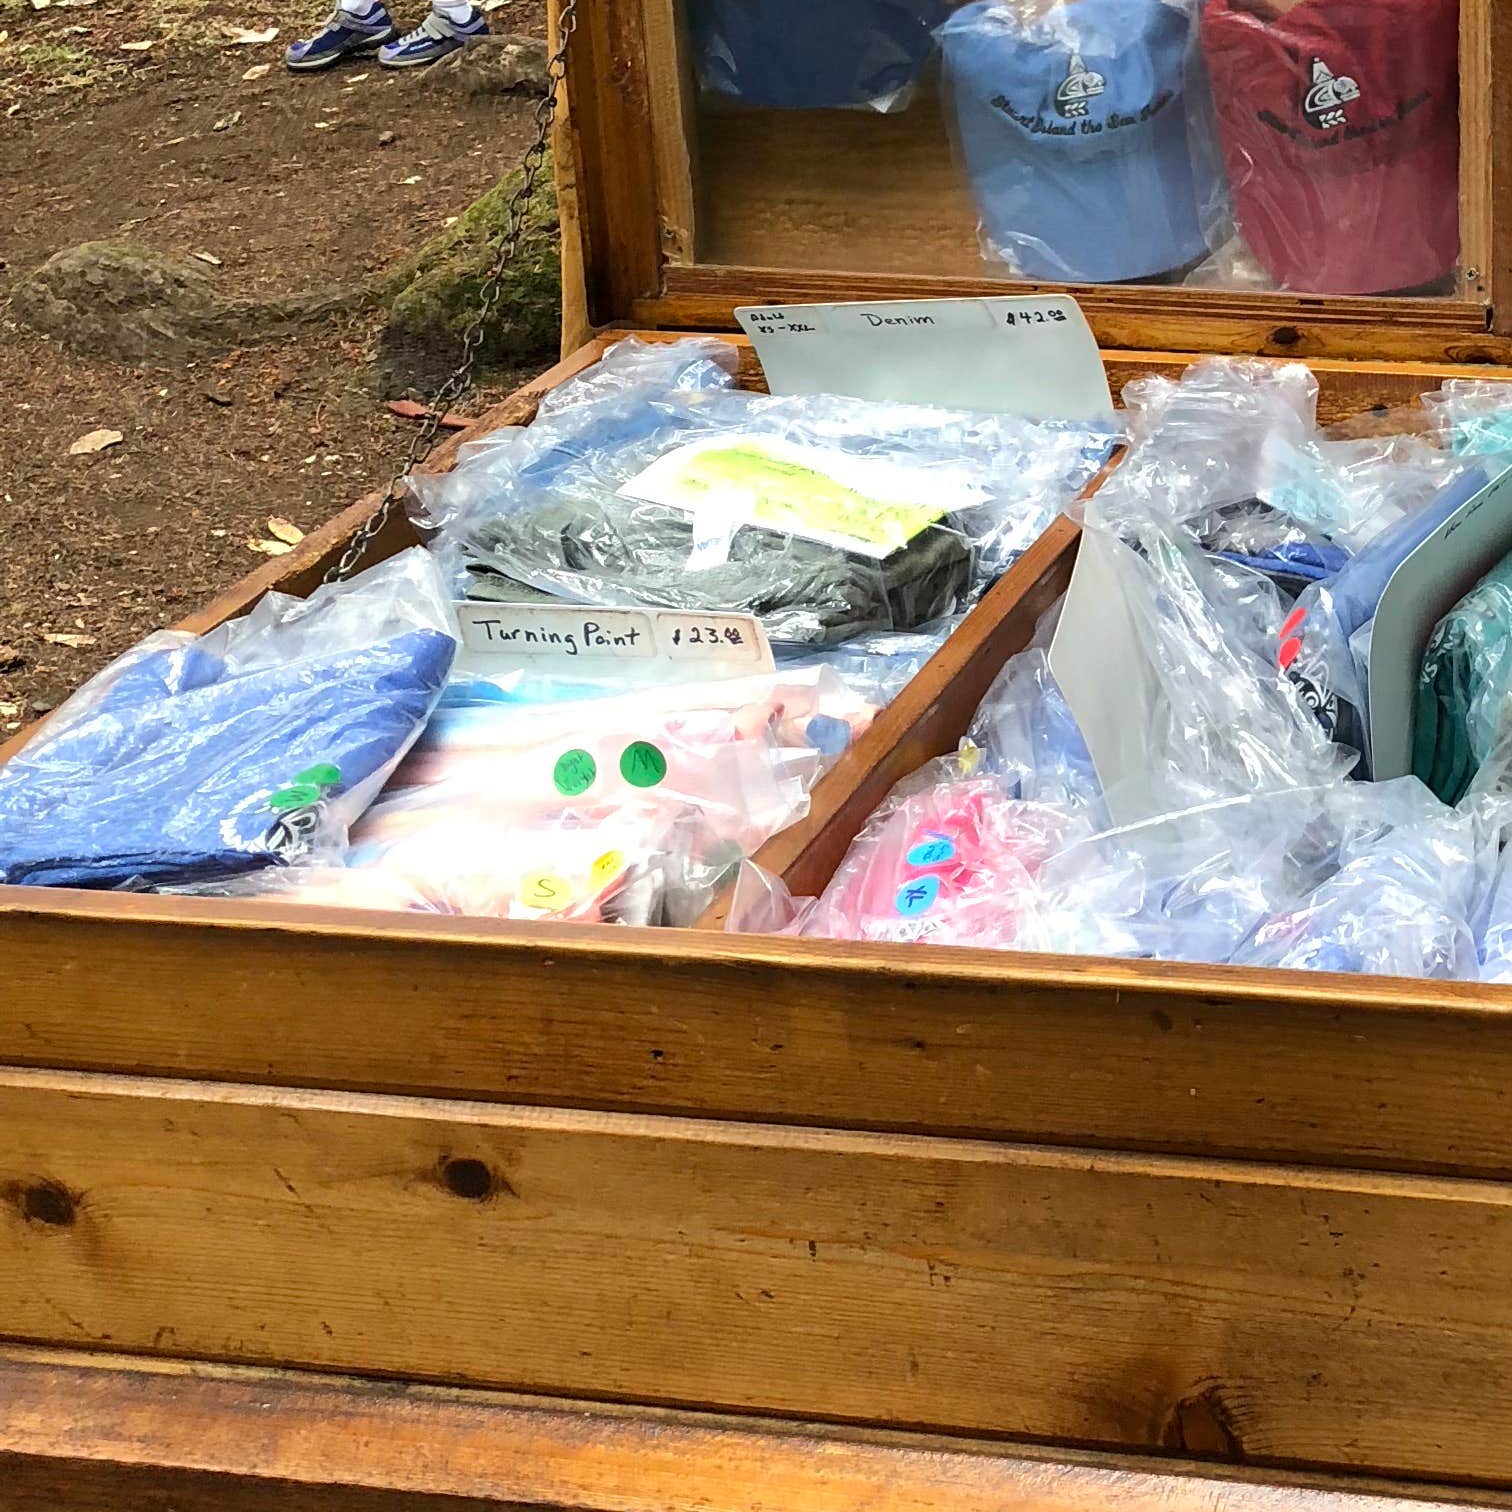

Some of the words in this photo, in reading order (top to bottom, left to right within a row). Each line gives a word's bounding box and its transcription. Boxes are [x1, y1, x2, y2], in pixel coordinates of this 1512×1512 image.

[859, 312, 936, 327] Denim
[471, 619, 578, 656] Turning
[583, 621, 641, 648] Point
[631, 748, 660, 775] M
[533, 878, 557, 898] S
